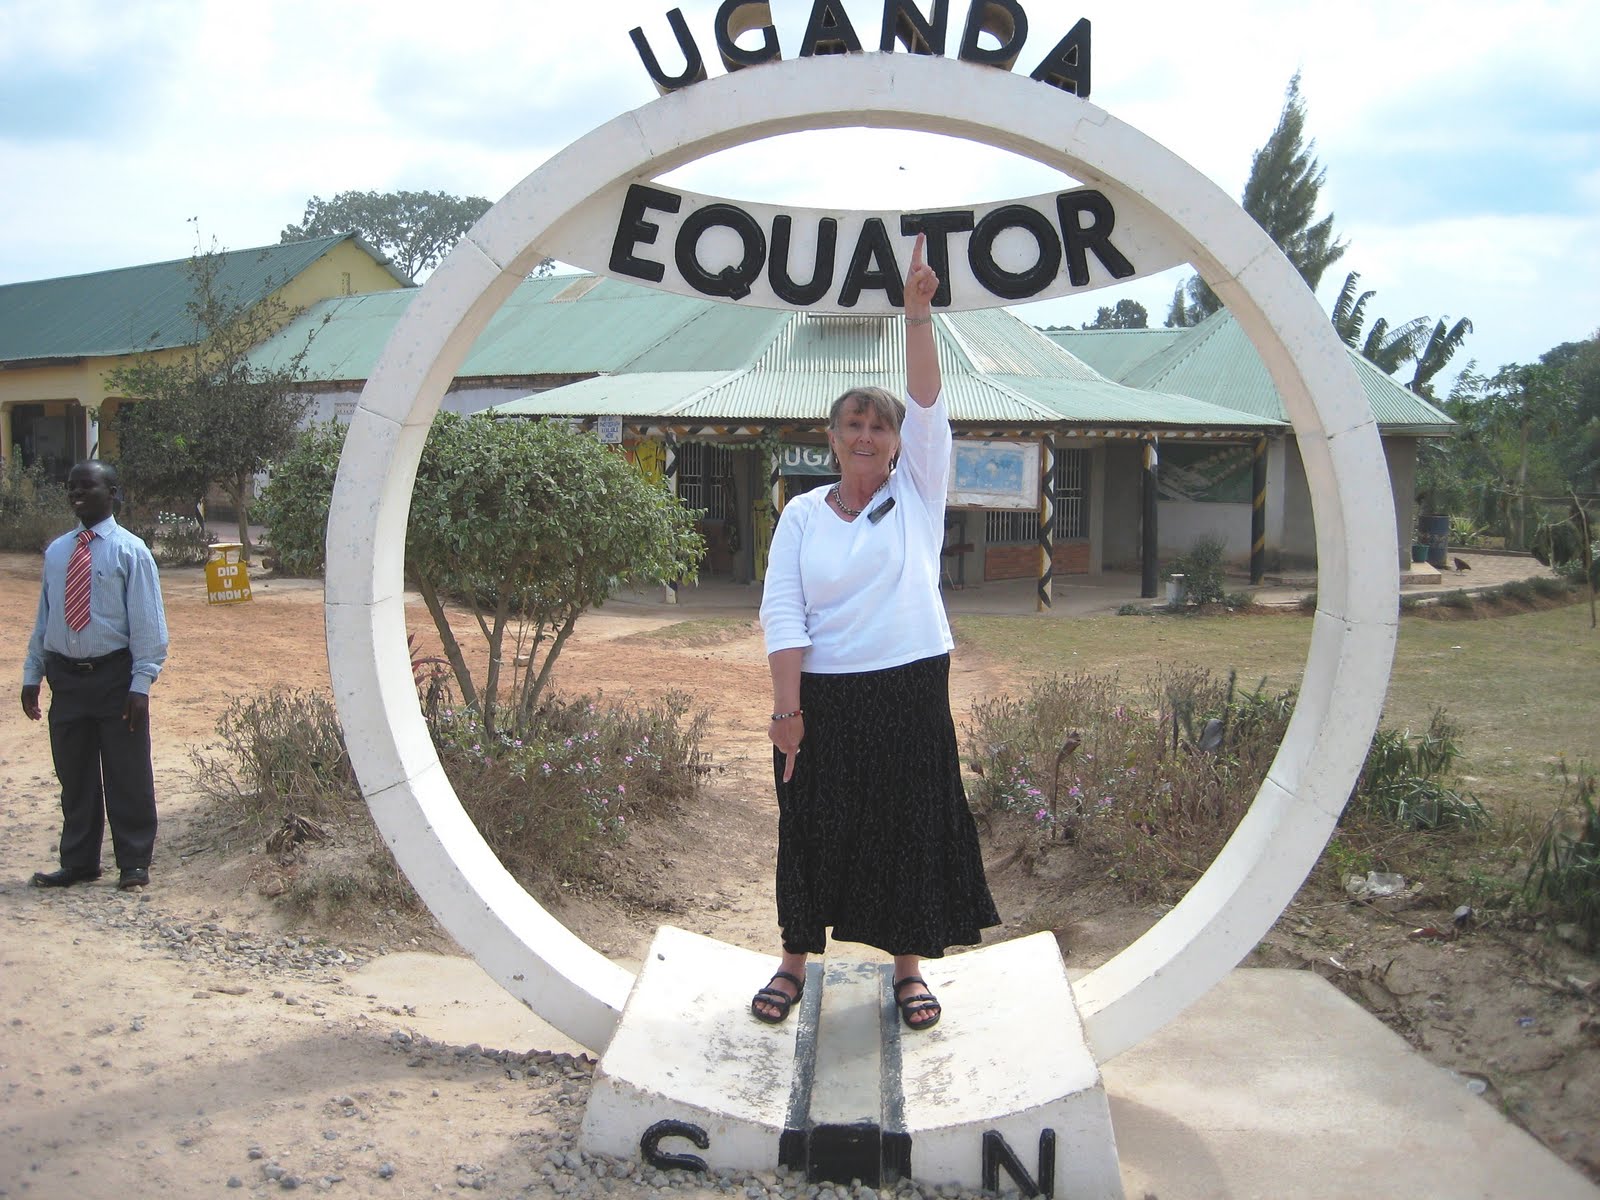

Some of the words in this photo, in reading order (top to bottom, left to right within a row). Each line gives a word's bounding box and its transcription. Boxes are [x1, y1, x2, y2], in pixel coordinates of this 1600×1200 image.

[629, 0, 1091, 98] UGANDA
[609, 183, 1136, 308] EQUATOR
[217, 566, 239, 577] DID
[223, 578, 232, 588] U
[982, 1128, 1056, 1199] N
